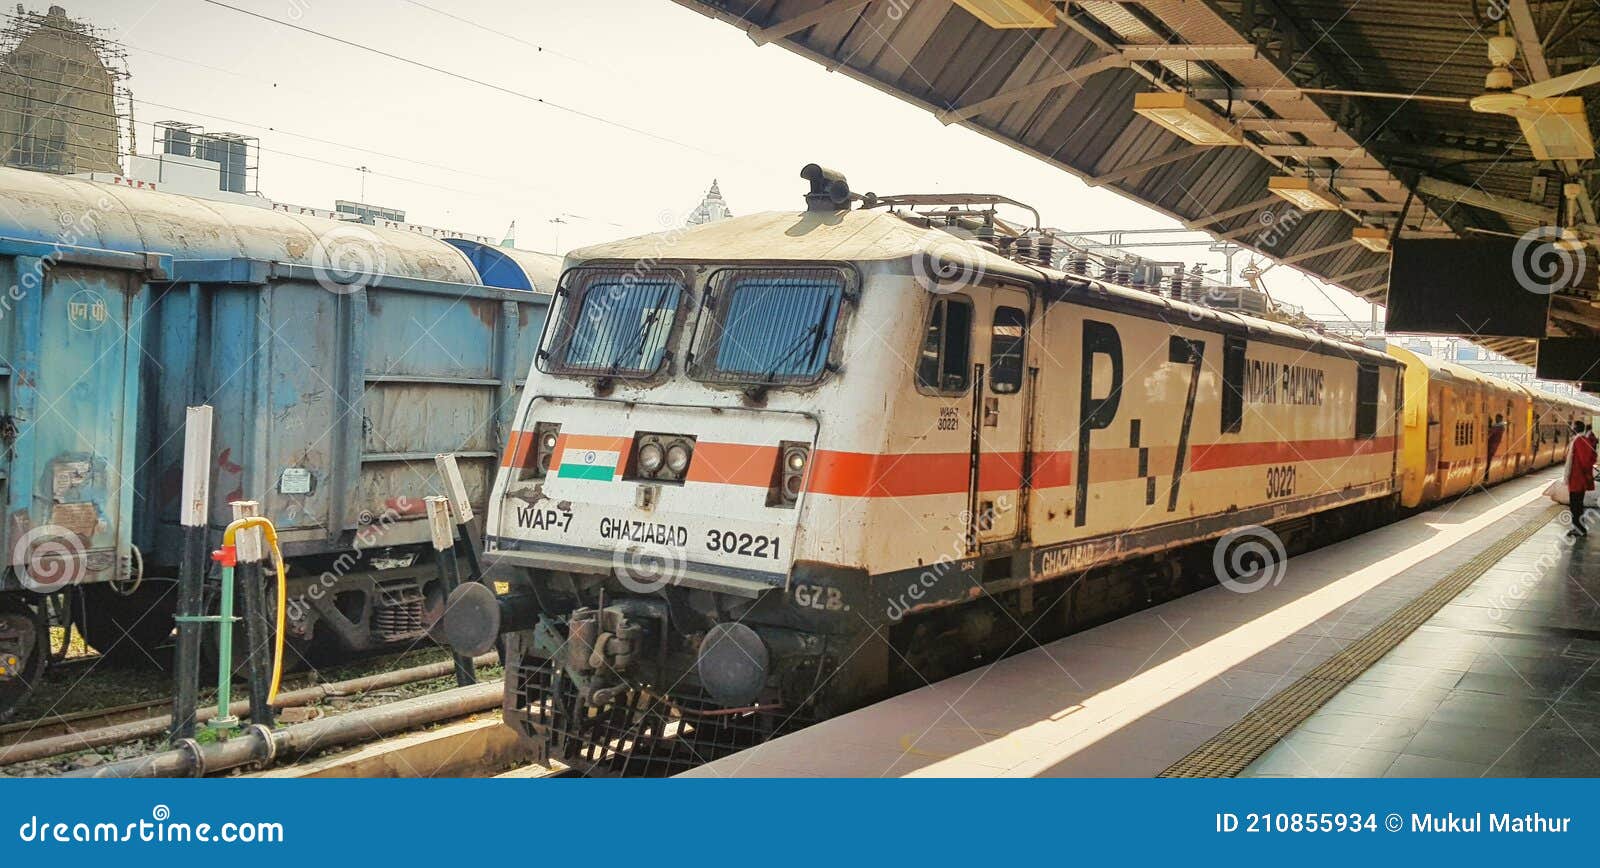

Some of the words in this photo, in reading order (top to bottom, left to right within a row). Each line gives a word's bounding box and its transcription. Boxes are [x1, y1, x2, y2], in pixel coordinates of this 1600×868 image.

[937, 418, 959, 430] 30221
[939, 407, 959, 417] WAP-7
[1266, 465, 1296, 499] 30221
[517, 507, 574, 533] WAP-7
[600, 517, 688, 547] GHAZIABAD
[706, 529, 781, 560] 30221
[795, 584, 850, 611] GZB.
